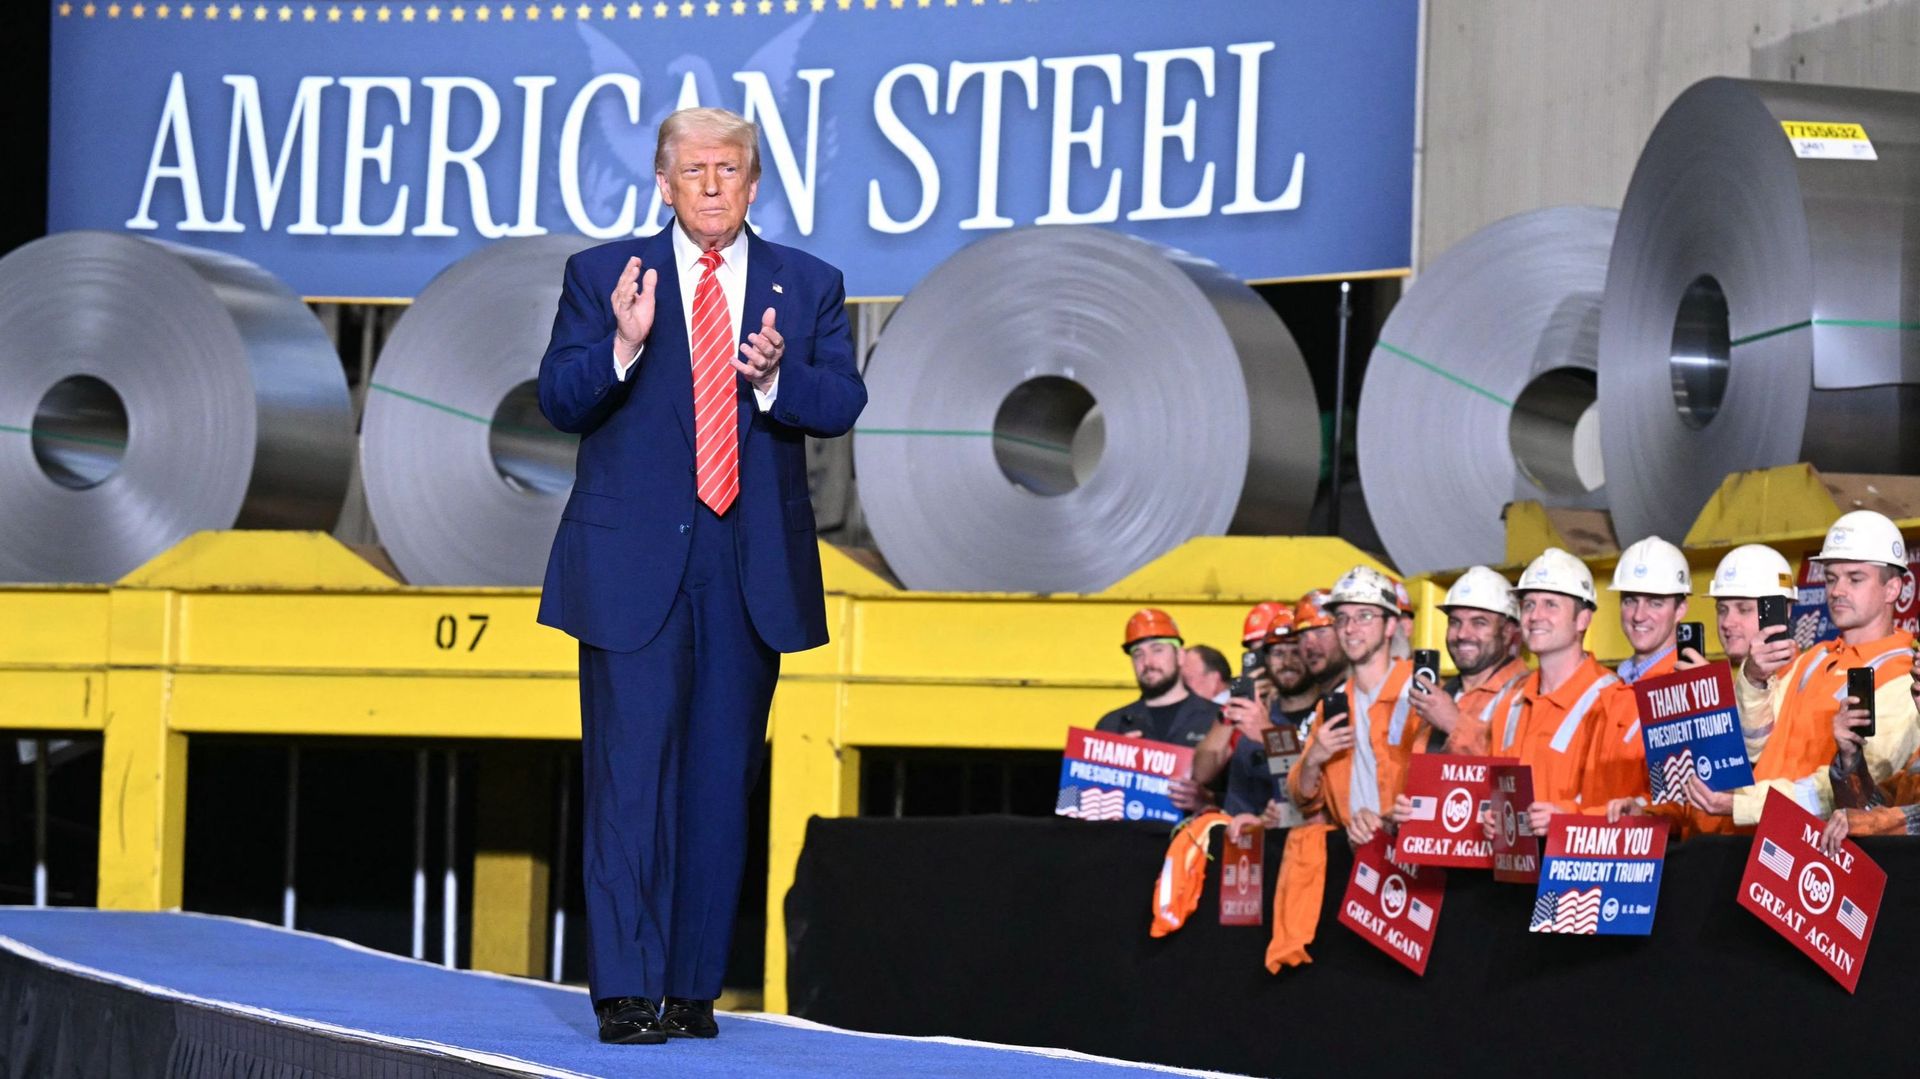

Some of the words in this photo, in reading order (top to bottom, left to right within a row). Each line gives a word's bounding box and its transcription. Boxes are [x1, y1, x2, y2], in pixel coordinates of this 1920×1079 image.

[868, 41, 1305, 234] STEEL
[1783, 124, 1861, 139] 7755632
[436, 614, 489, 652] 07
[1647, 682, 1690, 719] THANK
[1690, 676, 1720, 709] YOU
[1647, 719, 1693, 749] PRESIDENT
[1693, 711, 1734, 739] TRUMP!
[1069, 761, 1135, 788] PRESIDENT
[1083, 736, 1140, 770] THANK
[1142, 748, 1177, 775] YOU
[1441, 764, 1486, 783] MAKE
[1402, 836, 1452, 855] GREAT
[1564, 825, 1621, 855] THANK
[1623, 827, 1653, 856] YOU
[1801, 823, 1855, 875] MKE
[1549, 860, 1614, 882] PRESIDENT
[1614, 862, 1655, 883] TRUMP!
[1803, 870, 1830, 903] USS
[1346, 899, 1387, 936] GREAT
[1384, 927, 1423, 962] AGAIN
[1749, 881, 1806, 934] GREAT
[1804, 926, 1855, 976] AGAIN
